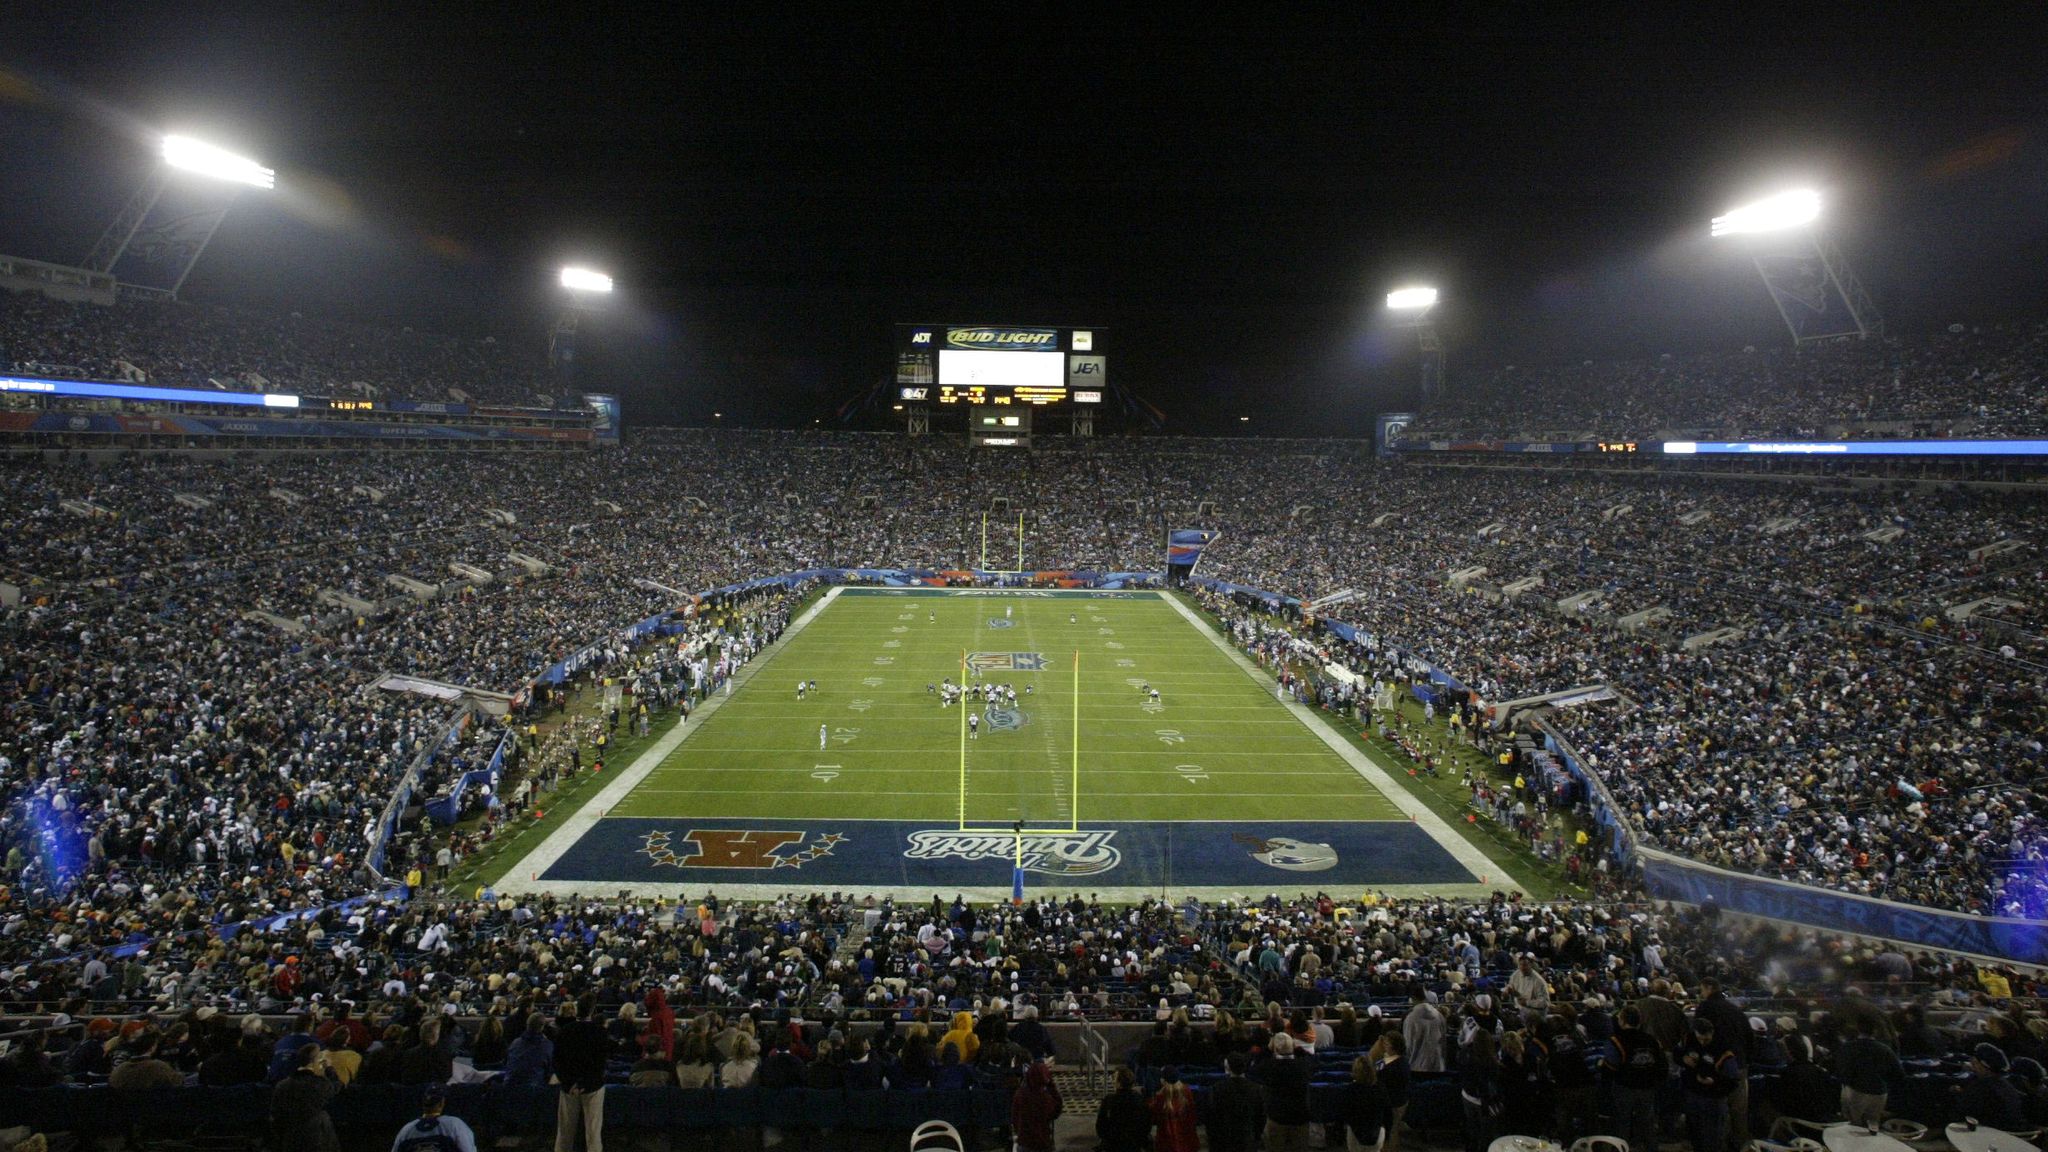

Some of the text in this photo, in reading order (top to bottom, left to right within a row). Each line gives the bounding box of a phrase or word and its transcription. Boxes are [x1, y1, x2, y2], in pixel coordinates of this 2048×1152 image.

[912, 332, 932, 343] ADT
[953, 332, 1054, 344] BUD LIGHT
[1073, 362, 1099, 375] JEA
[832, 727, 861, 740] 20
[1154, 729, 1185, 742] 20
[811, 764, 843, 778] 10
[1175, 764, 1210, 779] 10
[904, 830, 1121, 868] Patriots
[893, 961, 904, 973] 12
